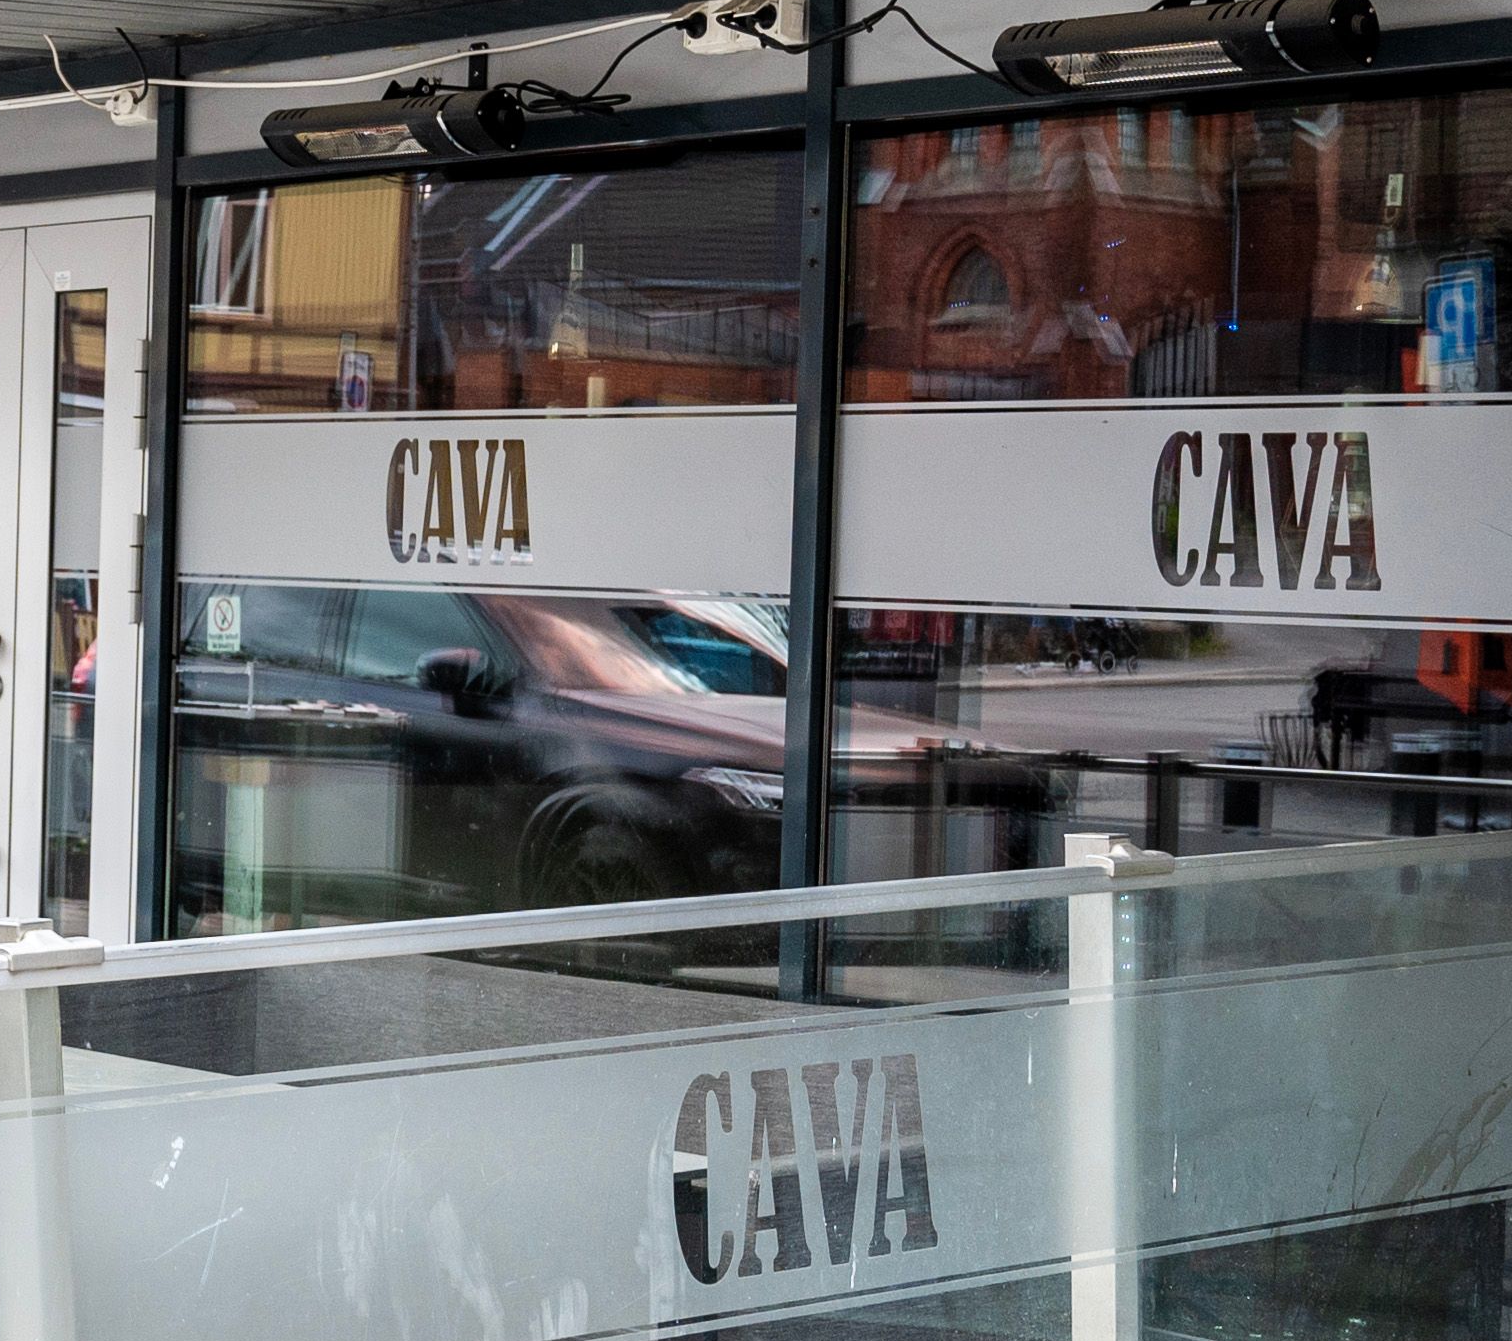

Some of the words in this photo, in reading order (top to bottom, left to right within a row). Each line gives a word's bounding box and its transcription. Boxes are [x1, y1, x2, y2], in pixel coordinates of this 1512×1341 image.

[386, 437, 535, 567] CAVA
[1151, 429, 1383, 592] CAVA
[670, 1053, 941, 1286] CAVA
